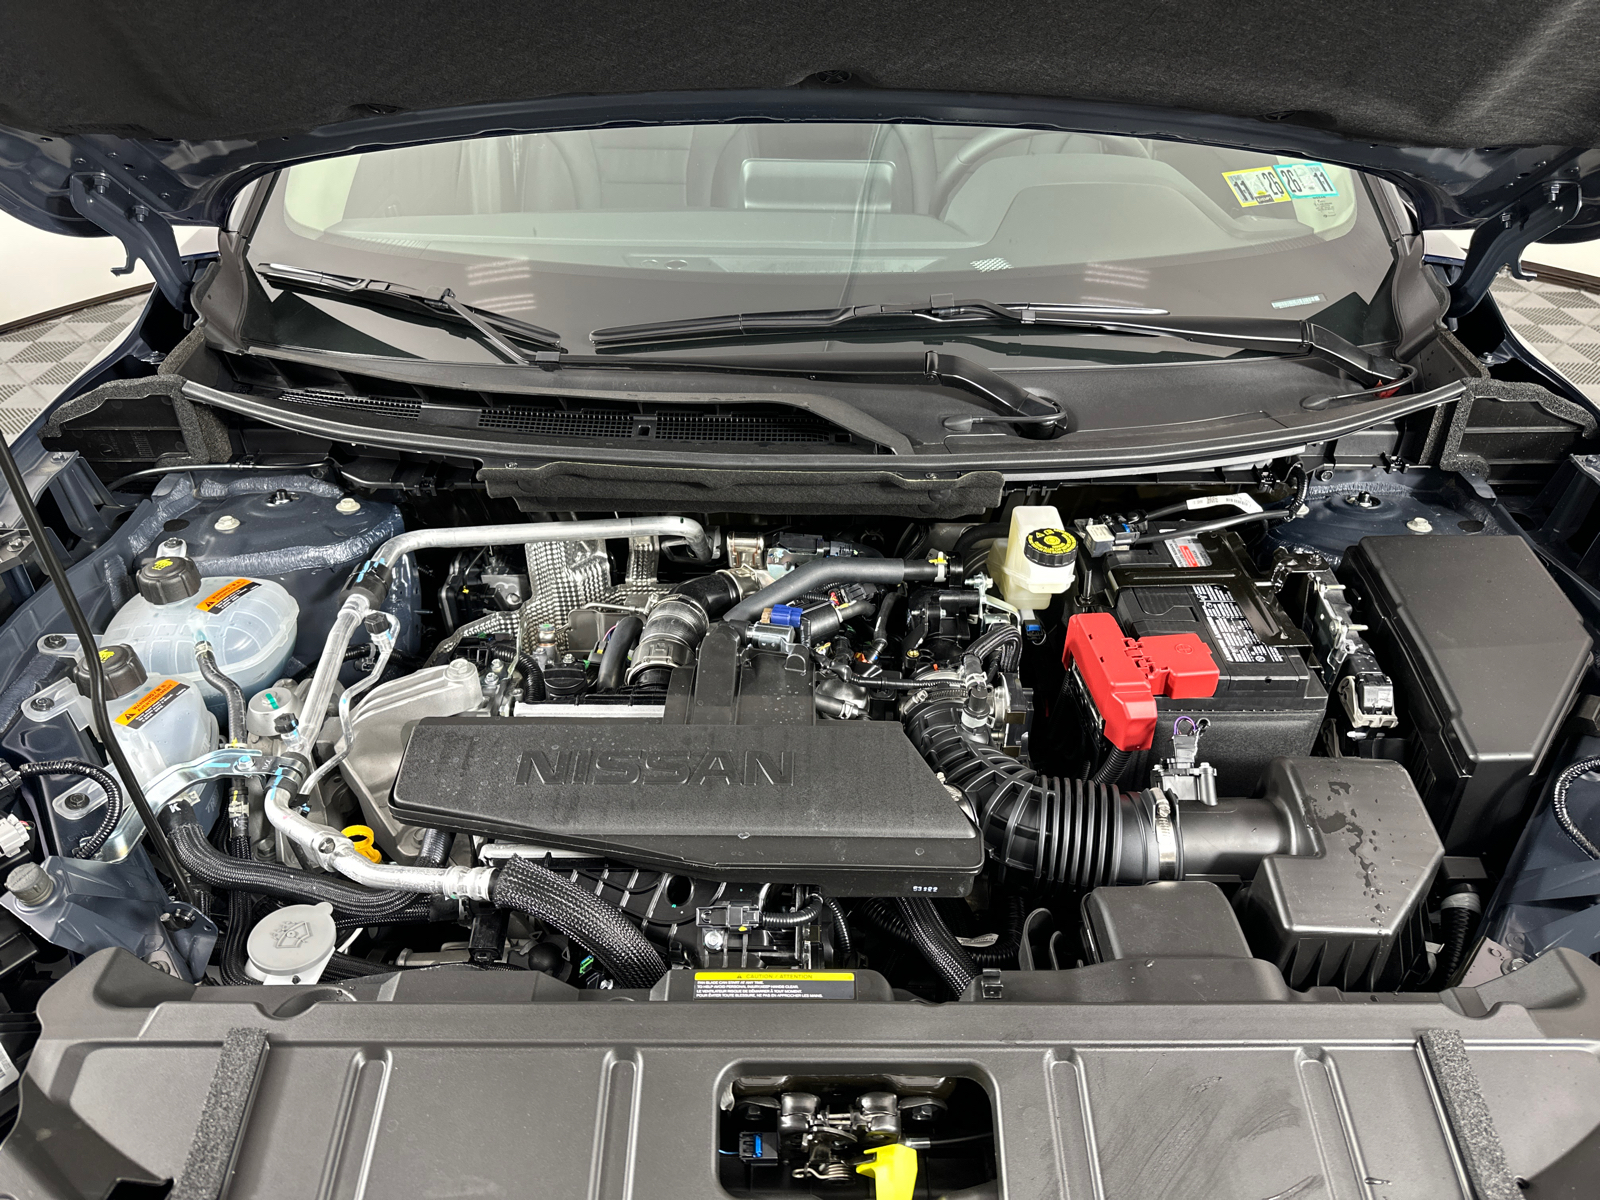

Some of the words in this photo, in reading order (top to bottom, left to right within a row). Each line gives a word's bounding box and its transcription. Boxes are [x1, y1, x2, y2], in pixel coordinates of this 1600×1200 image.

[1234, 180, 1254, 202] 11
[1262, 172, 1284, 196] 26
[1281, 170, 1302, 193] 26
[1314, 172, 1334, 192] 11
[514, 749, 795, 786] NISSAN
[168, 802, 181, 814] K
